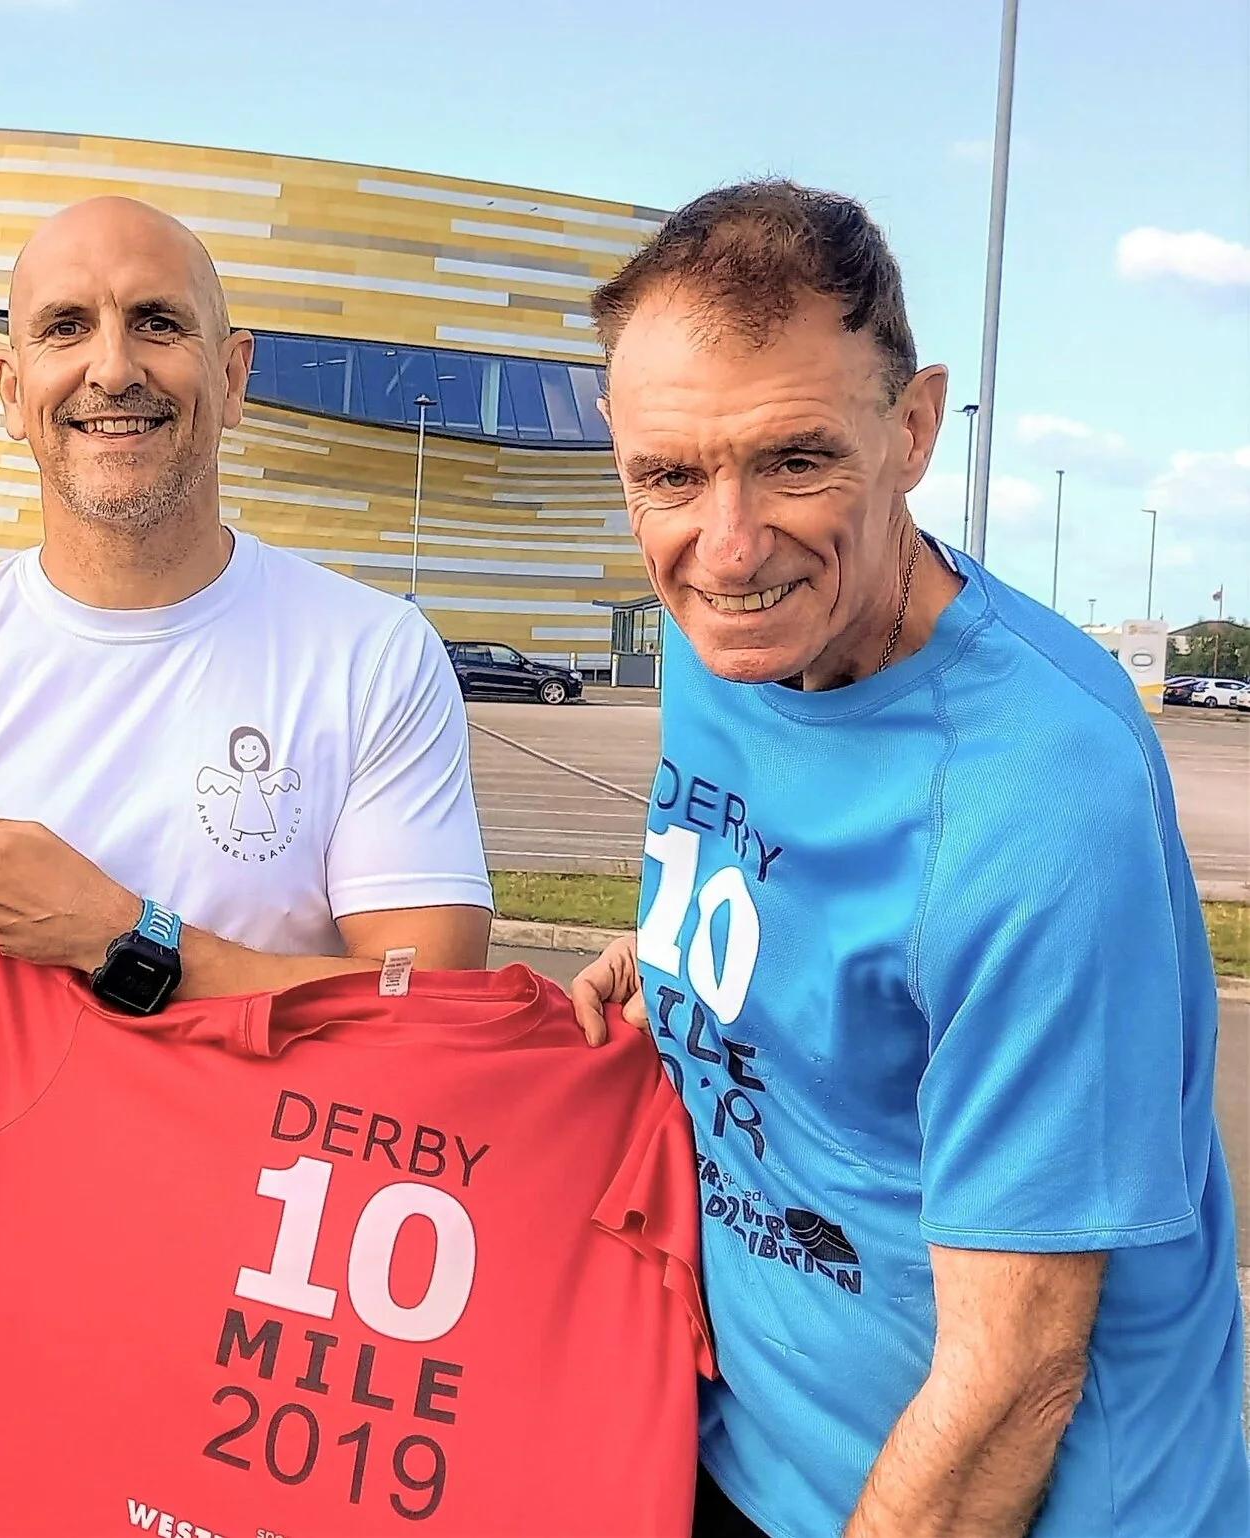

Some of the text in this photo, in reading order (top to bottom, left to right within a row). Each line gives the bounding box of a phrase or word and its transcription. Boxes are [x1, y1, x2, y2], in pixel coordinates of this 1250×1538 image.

[196, 803, 302, 862] ANNABEL'S ANGELS
[656, 756, 785, 883] DERY
[636, 823, 761, 1026] 10
[638, 975, 766, 1093] ILE
[270, 1089, 491, 1188] DERBY
[234, 1154, 478, 1343] 10
[215, 1307, 464, 1426] MILE
[202, 1384, 447, 1522] 2019
